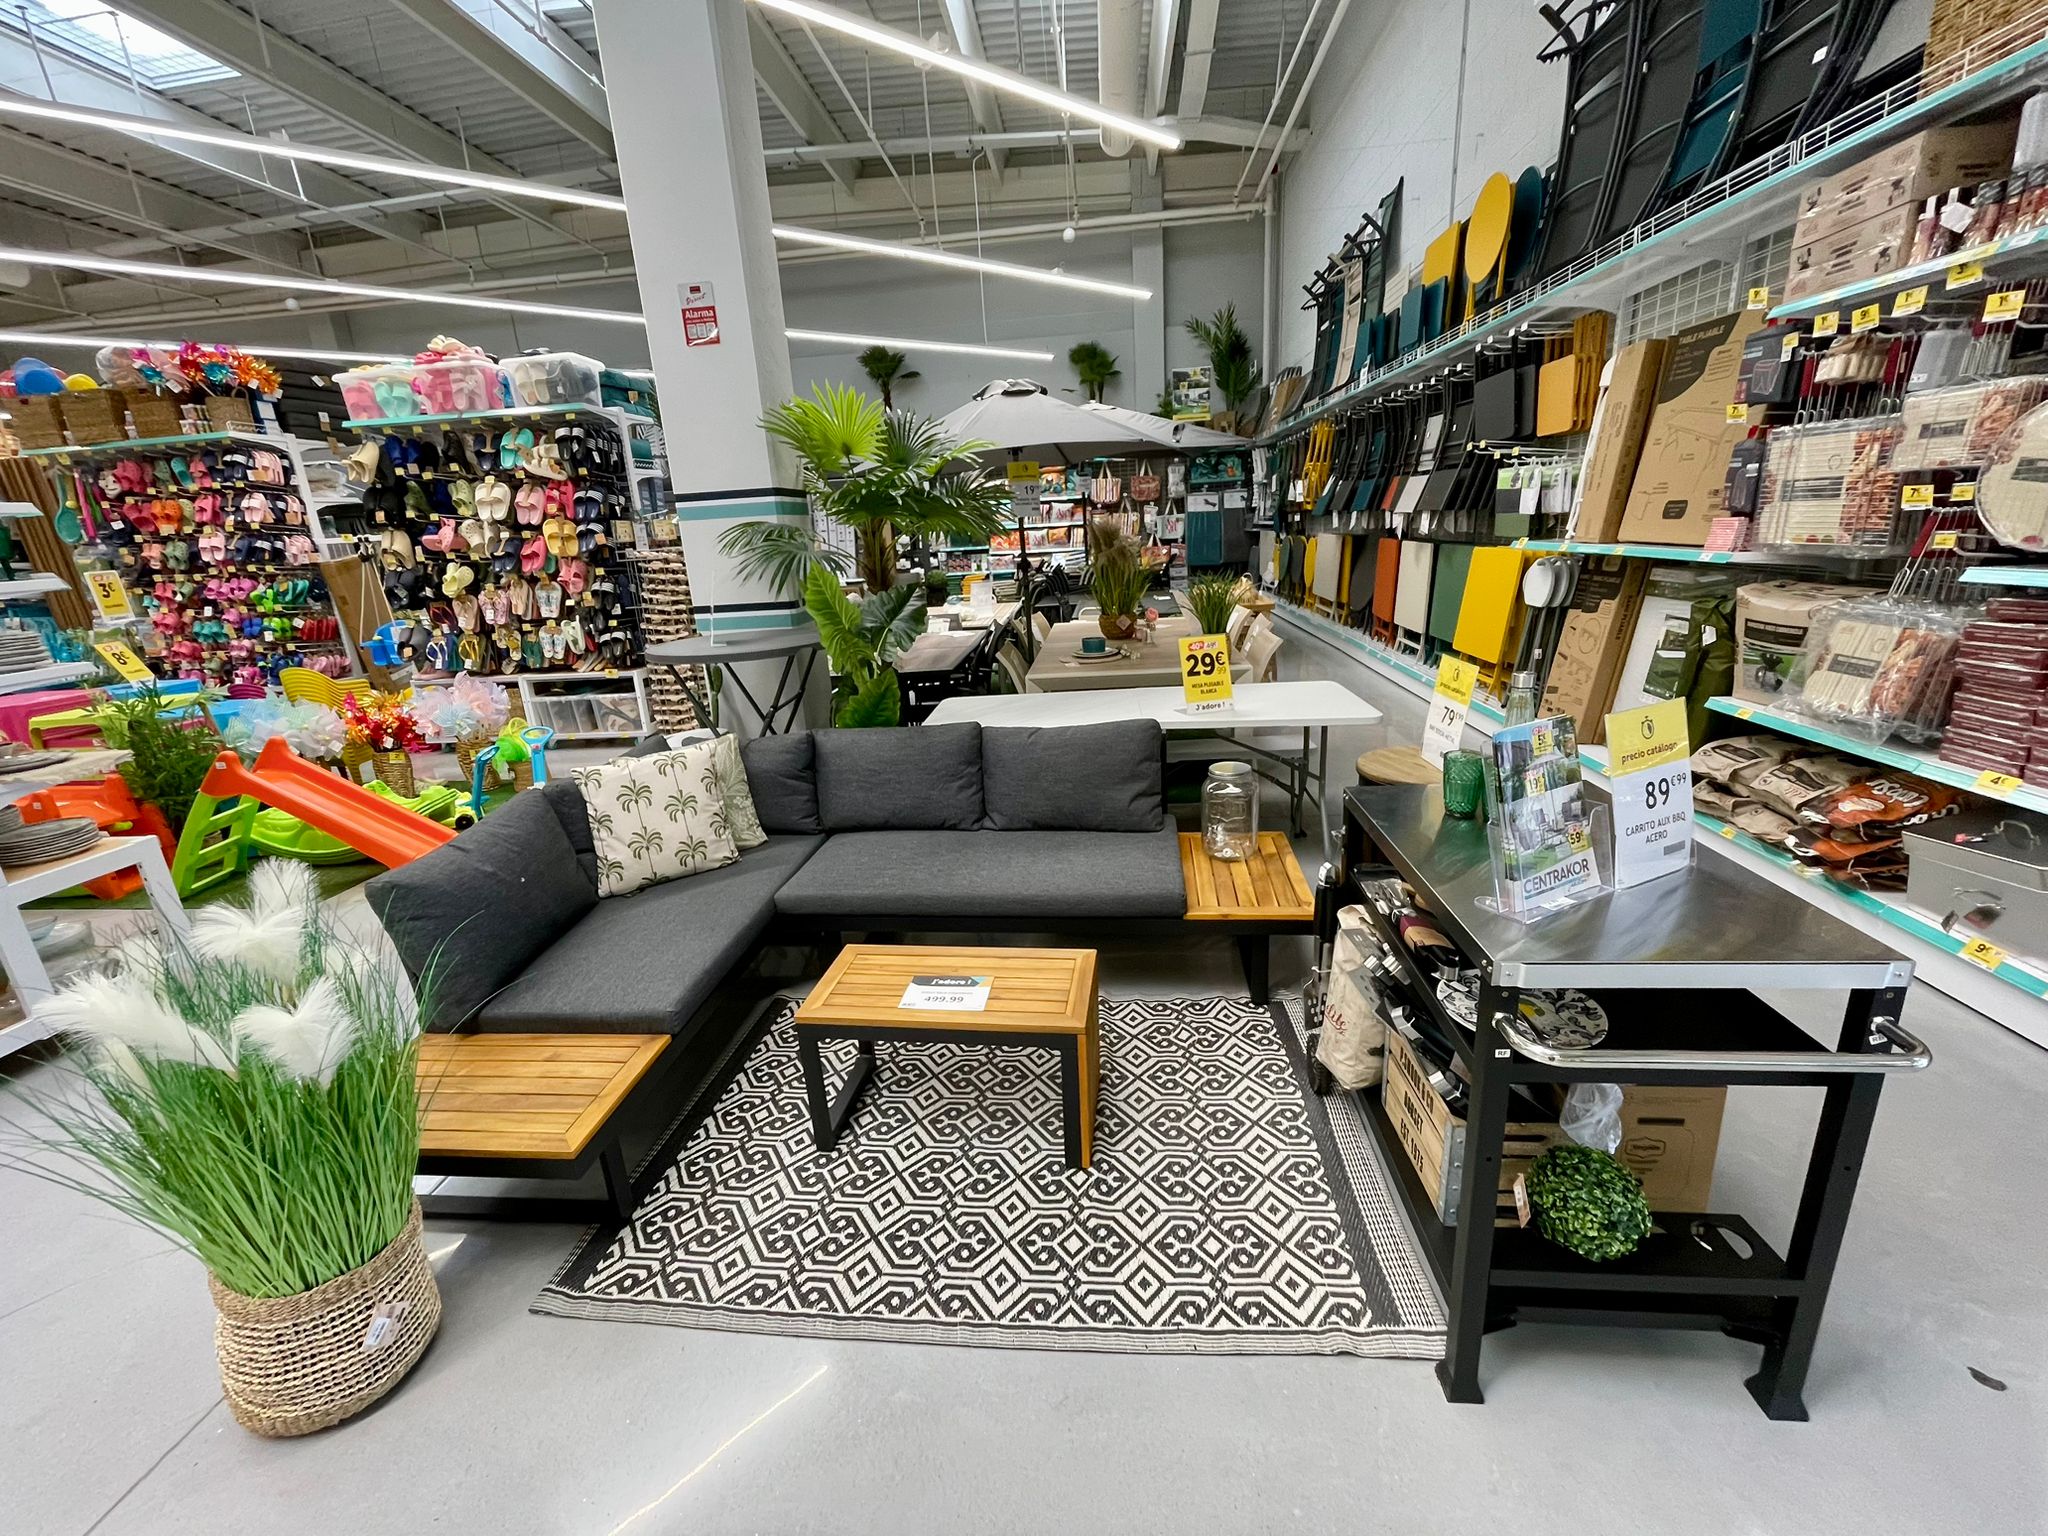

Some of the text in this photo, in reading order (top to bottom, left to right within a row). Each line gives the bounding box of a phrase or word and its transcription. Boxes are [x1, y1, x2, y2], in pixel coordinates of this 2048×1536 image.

[685, 309, 714, 319] Alarma
[1621, 742, 1678, 765] precio catálogo
[1625, 811, 1686, 837] CARRITO AUX BBQ
[1645, 829, 1668, 844] ACERO
[1523, 858, 1590, 894] CENTRAKOR
[1403, 1090, 1424, 1135] DORSET
